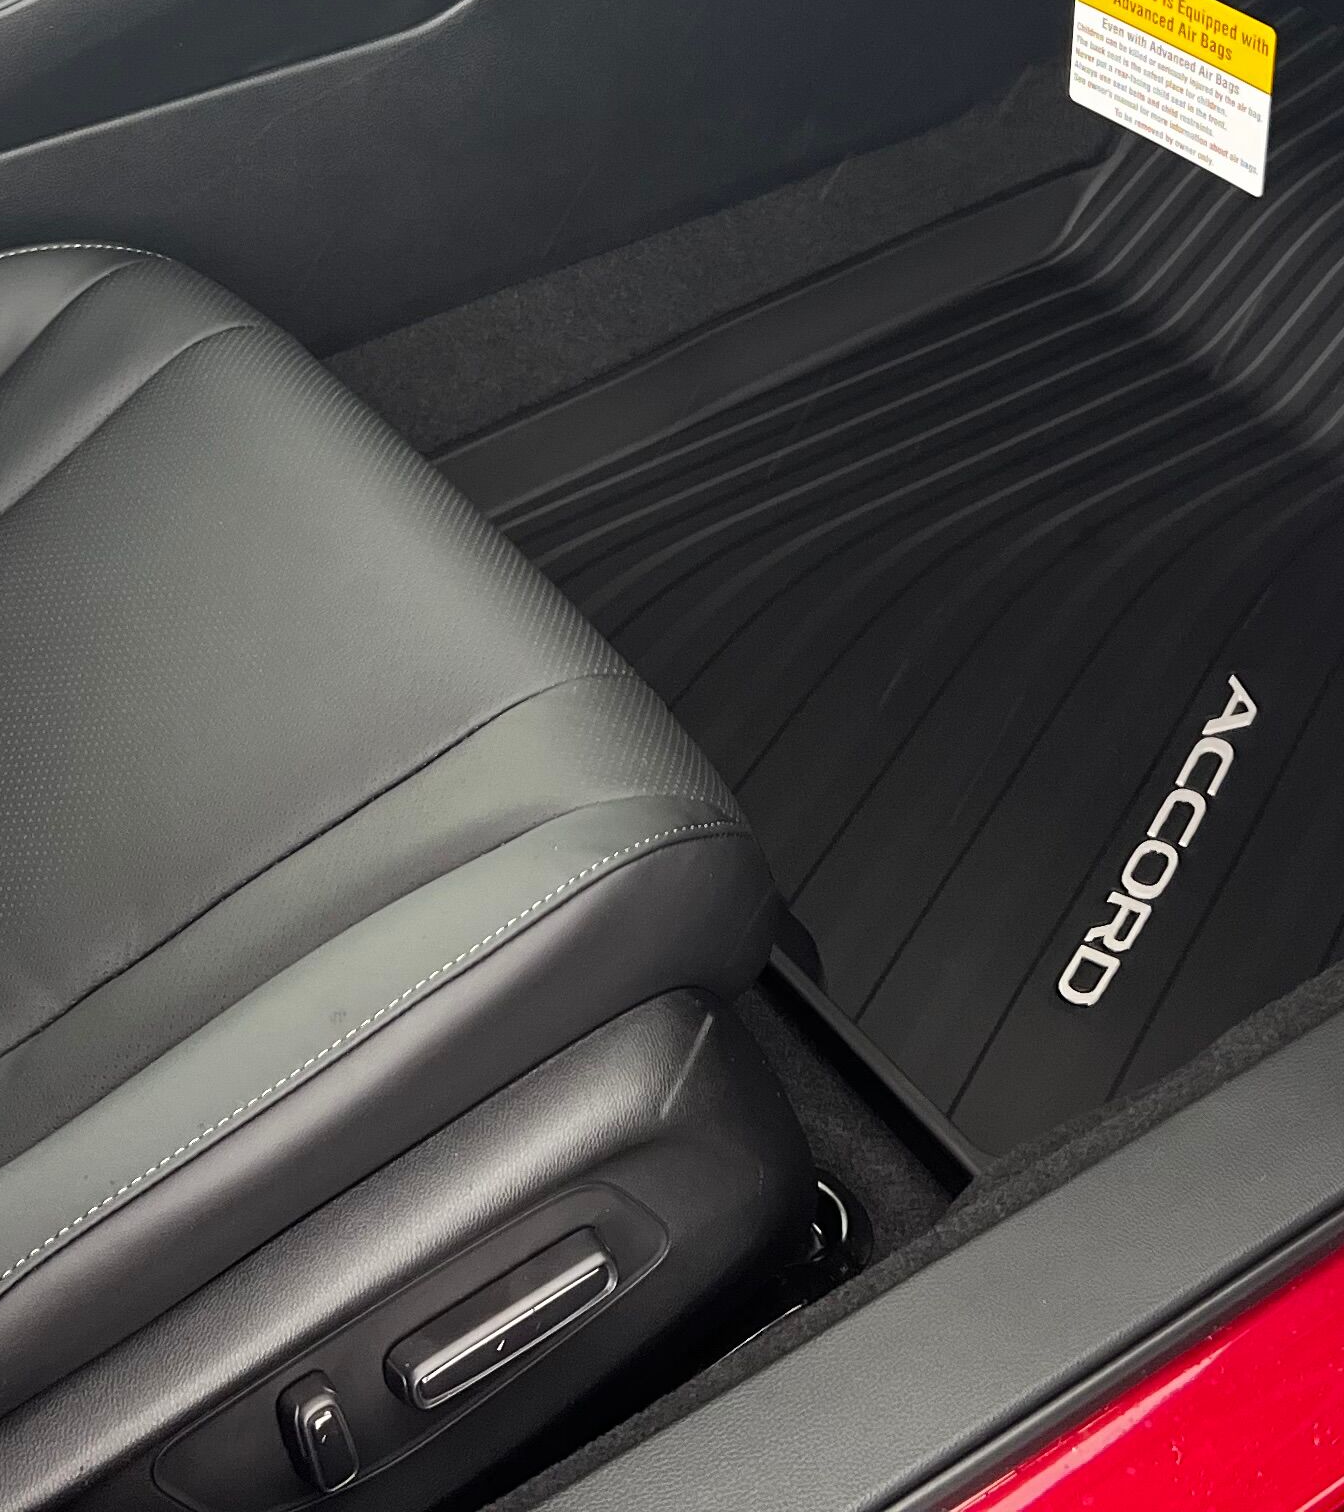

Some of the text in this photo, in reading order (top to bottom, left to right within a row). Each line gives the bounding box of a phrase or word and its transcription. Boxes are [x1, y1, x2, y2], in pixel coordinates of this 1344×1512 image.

[1103, 17, 1241, 96] Even with Advanced Air Bags
[1179, 21, 1197, 43] Air
[1201, 32, 1233, 63] Bags
[1242, 29, 1270, 56] with
[1057, 674, 1257, 1006] ACCORD
